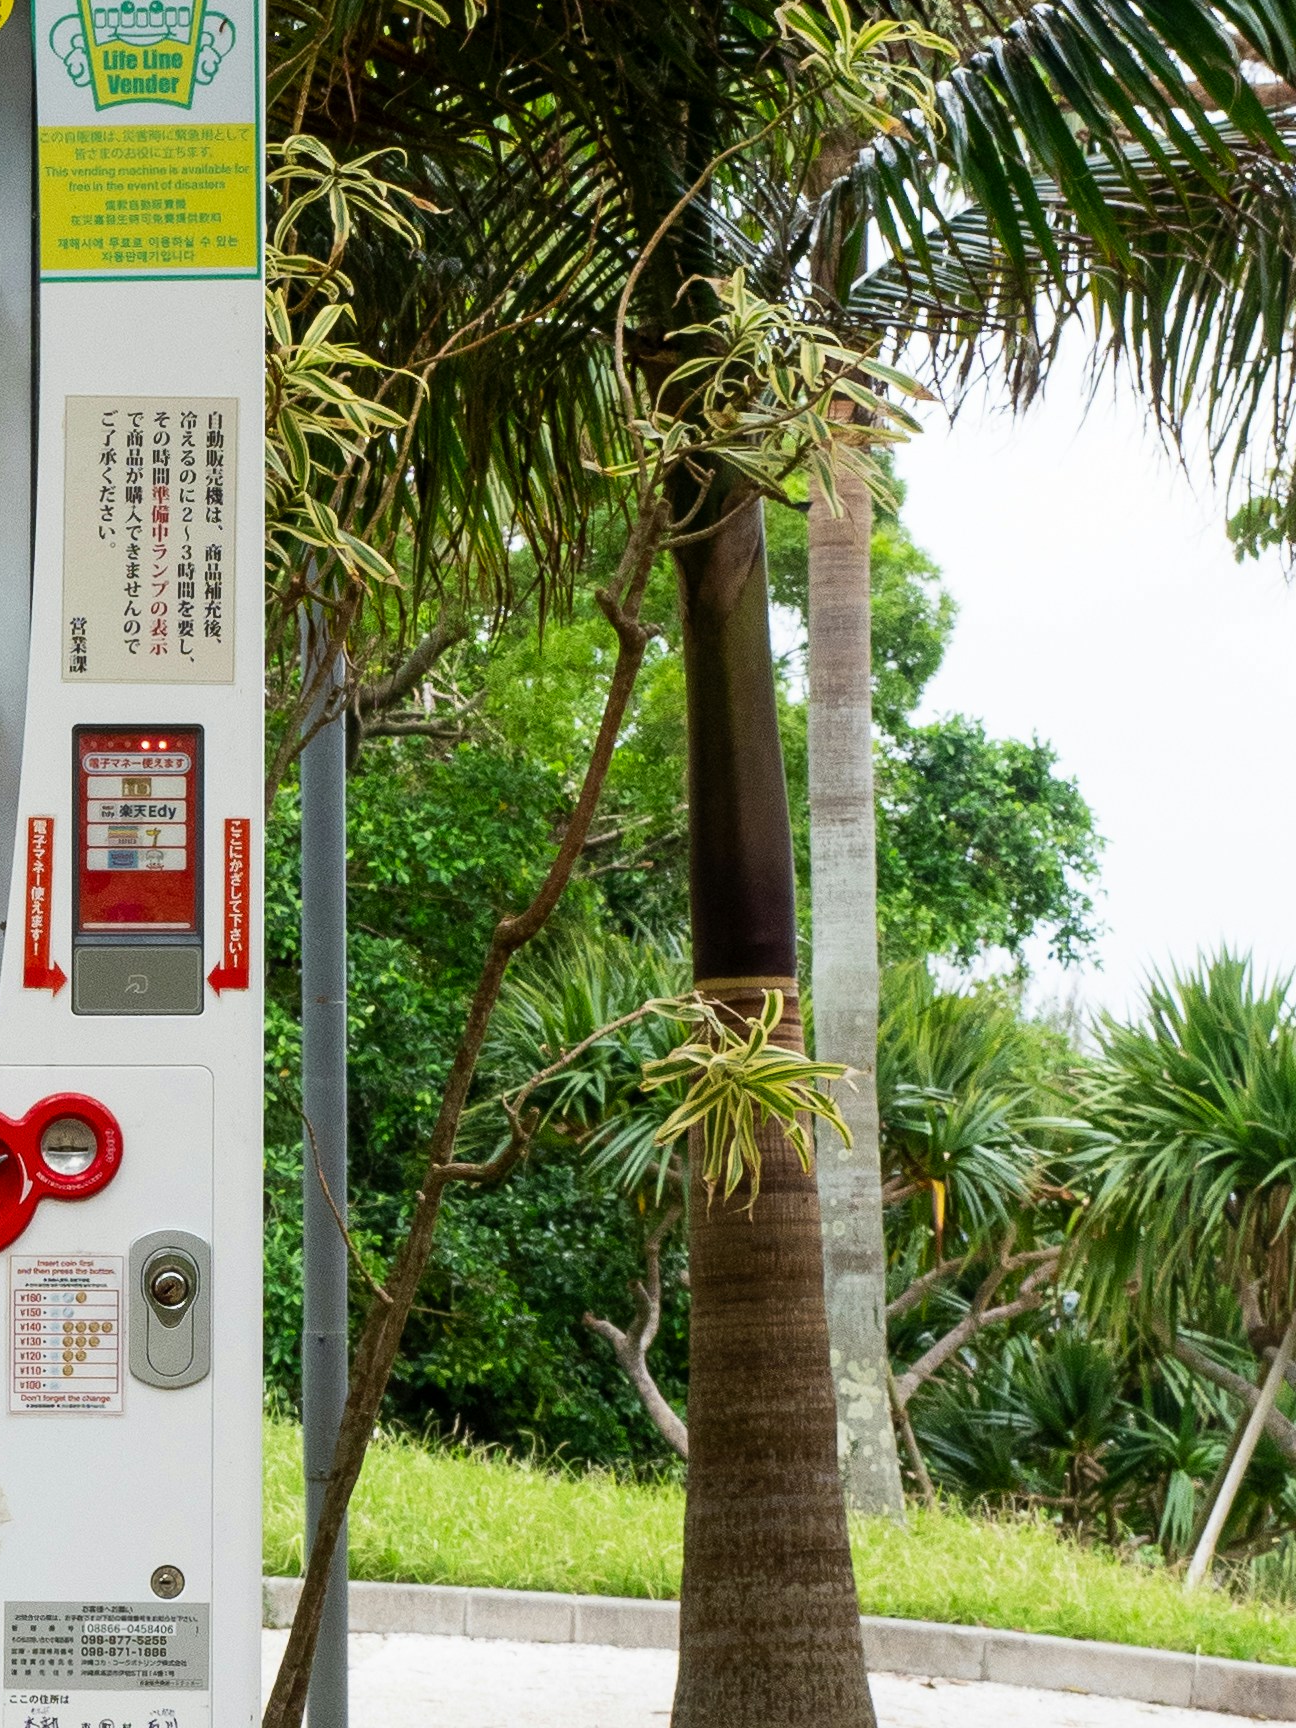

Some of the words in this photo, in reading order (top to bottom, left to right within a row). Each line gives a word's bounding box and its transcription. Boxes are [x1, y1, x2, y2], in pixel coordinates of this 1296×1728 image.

[103, 50, 137, 69] Life
[143, 49, 182, 69] Line
[45, 166, 68, 177] This
[72, 167, 115, 178] vending
[118, 166, 166, 175] machine
[169, 165, 178, 174] is
[181, 164, 230, 174] available
[235, 165, 250, 174] for
[69, 182, 90, 191] free
[93, 181, 102, 190] in
[106, 181, 123, 190] the
[127, 181, 158, 190] event
[161, 180, 172, 189] of
[175, 180, 225, 189] disasters
[98, 409, 118, 549] ご了承ください。
[124, 410, 144, 655] で商品が購入できませんので
[149, 410, 171, 656] その時間準備中ランプの表示
[205, 410, 224, 644] 自動販売機は、商品補充後、
[69, 616, 88, 673] 営業課
[89, 758, 184, 769] 電子マネー使えます
[120, 804, 176, 820] 楽天Edy
[31, 820, 47, 955] 電子マネー使えます!
[229, 821, 243, 967] ここにかざして下さい!
[20, 1308, 41, 1317] ¥150
[20, 1337, 41, 1346] ¥130
[43, 1395, 66, 1403] forget
[87, 1624, 174, 1633] 08866-0458406
[9, 1695, 69, 1704] ここの住所は
